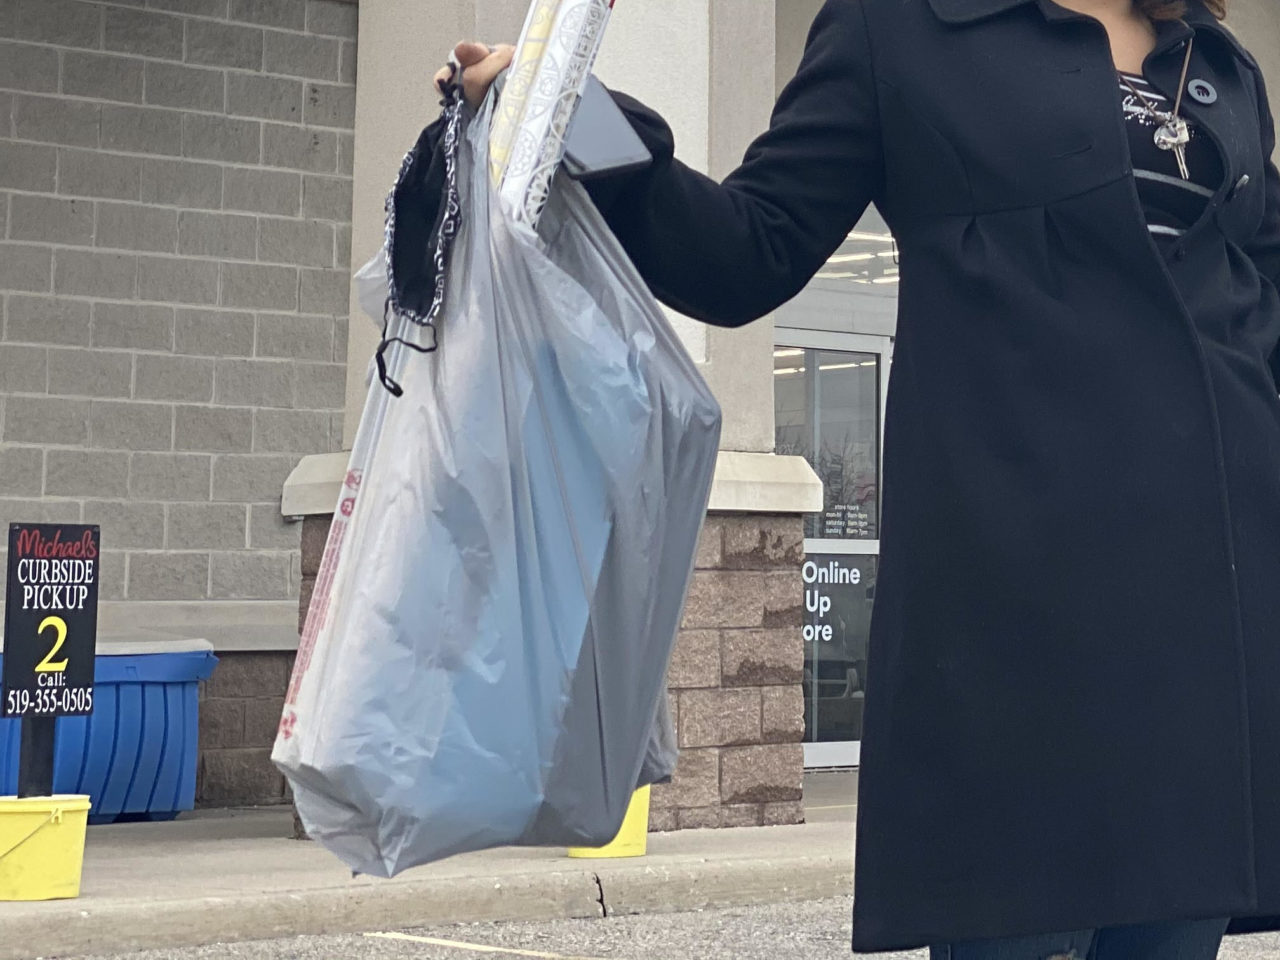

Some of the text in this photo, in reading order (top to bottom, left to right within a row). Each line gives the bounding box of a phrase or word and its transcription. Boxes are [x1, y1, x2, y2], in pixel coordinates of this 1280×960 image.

[17, 529, 97, 558] Michaels
[17, 559, 94, 583] CURBSIDE
[801, 561, 861, 584] Online
[805, 589, 831, 618] Up
[34, 615, 69, 672] 2
[801, 624, 833, 642] ore
[37, 672, 66, 687] Call:
[7, 687, 93, 714] 519-355-0505
